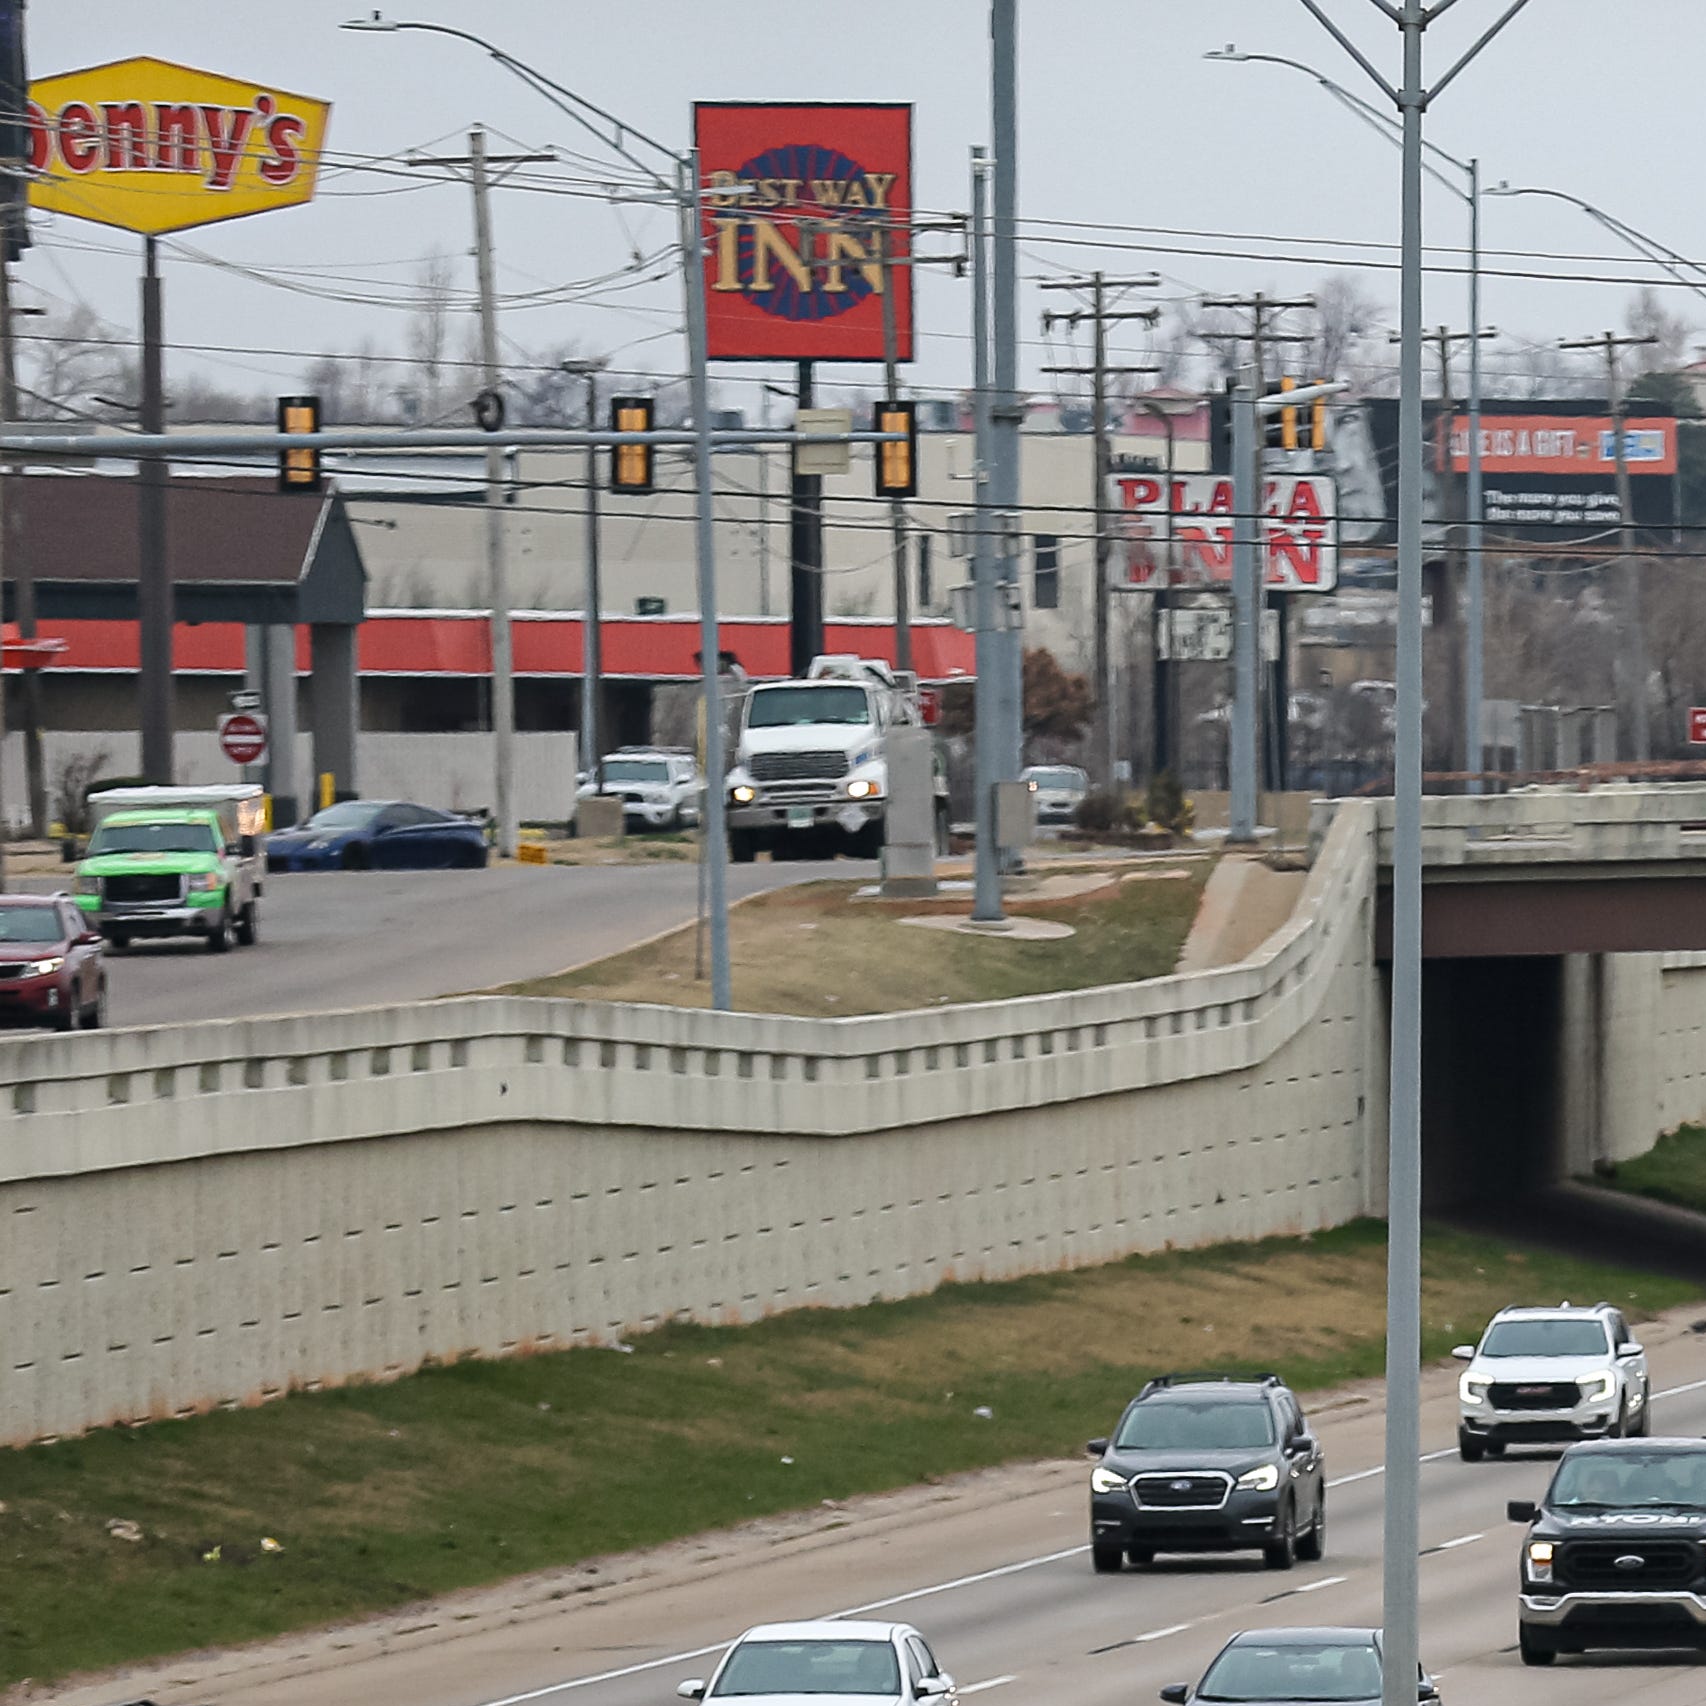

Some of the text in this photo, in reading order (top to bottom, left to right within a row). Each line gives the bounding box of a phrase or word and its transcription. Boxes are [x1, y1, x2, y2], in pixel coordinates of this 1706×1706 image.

[710, 169, 898, 209] BEST WAY
[710, 217, 888, 294] INN
